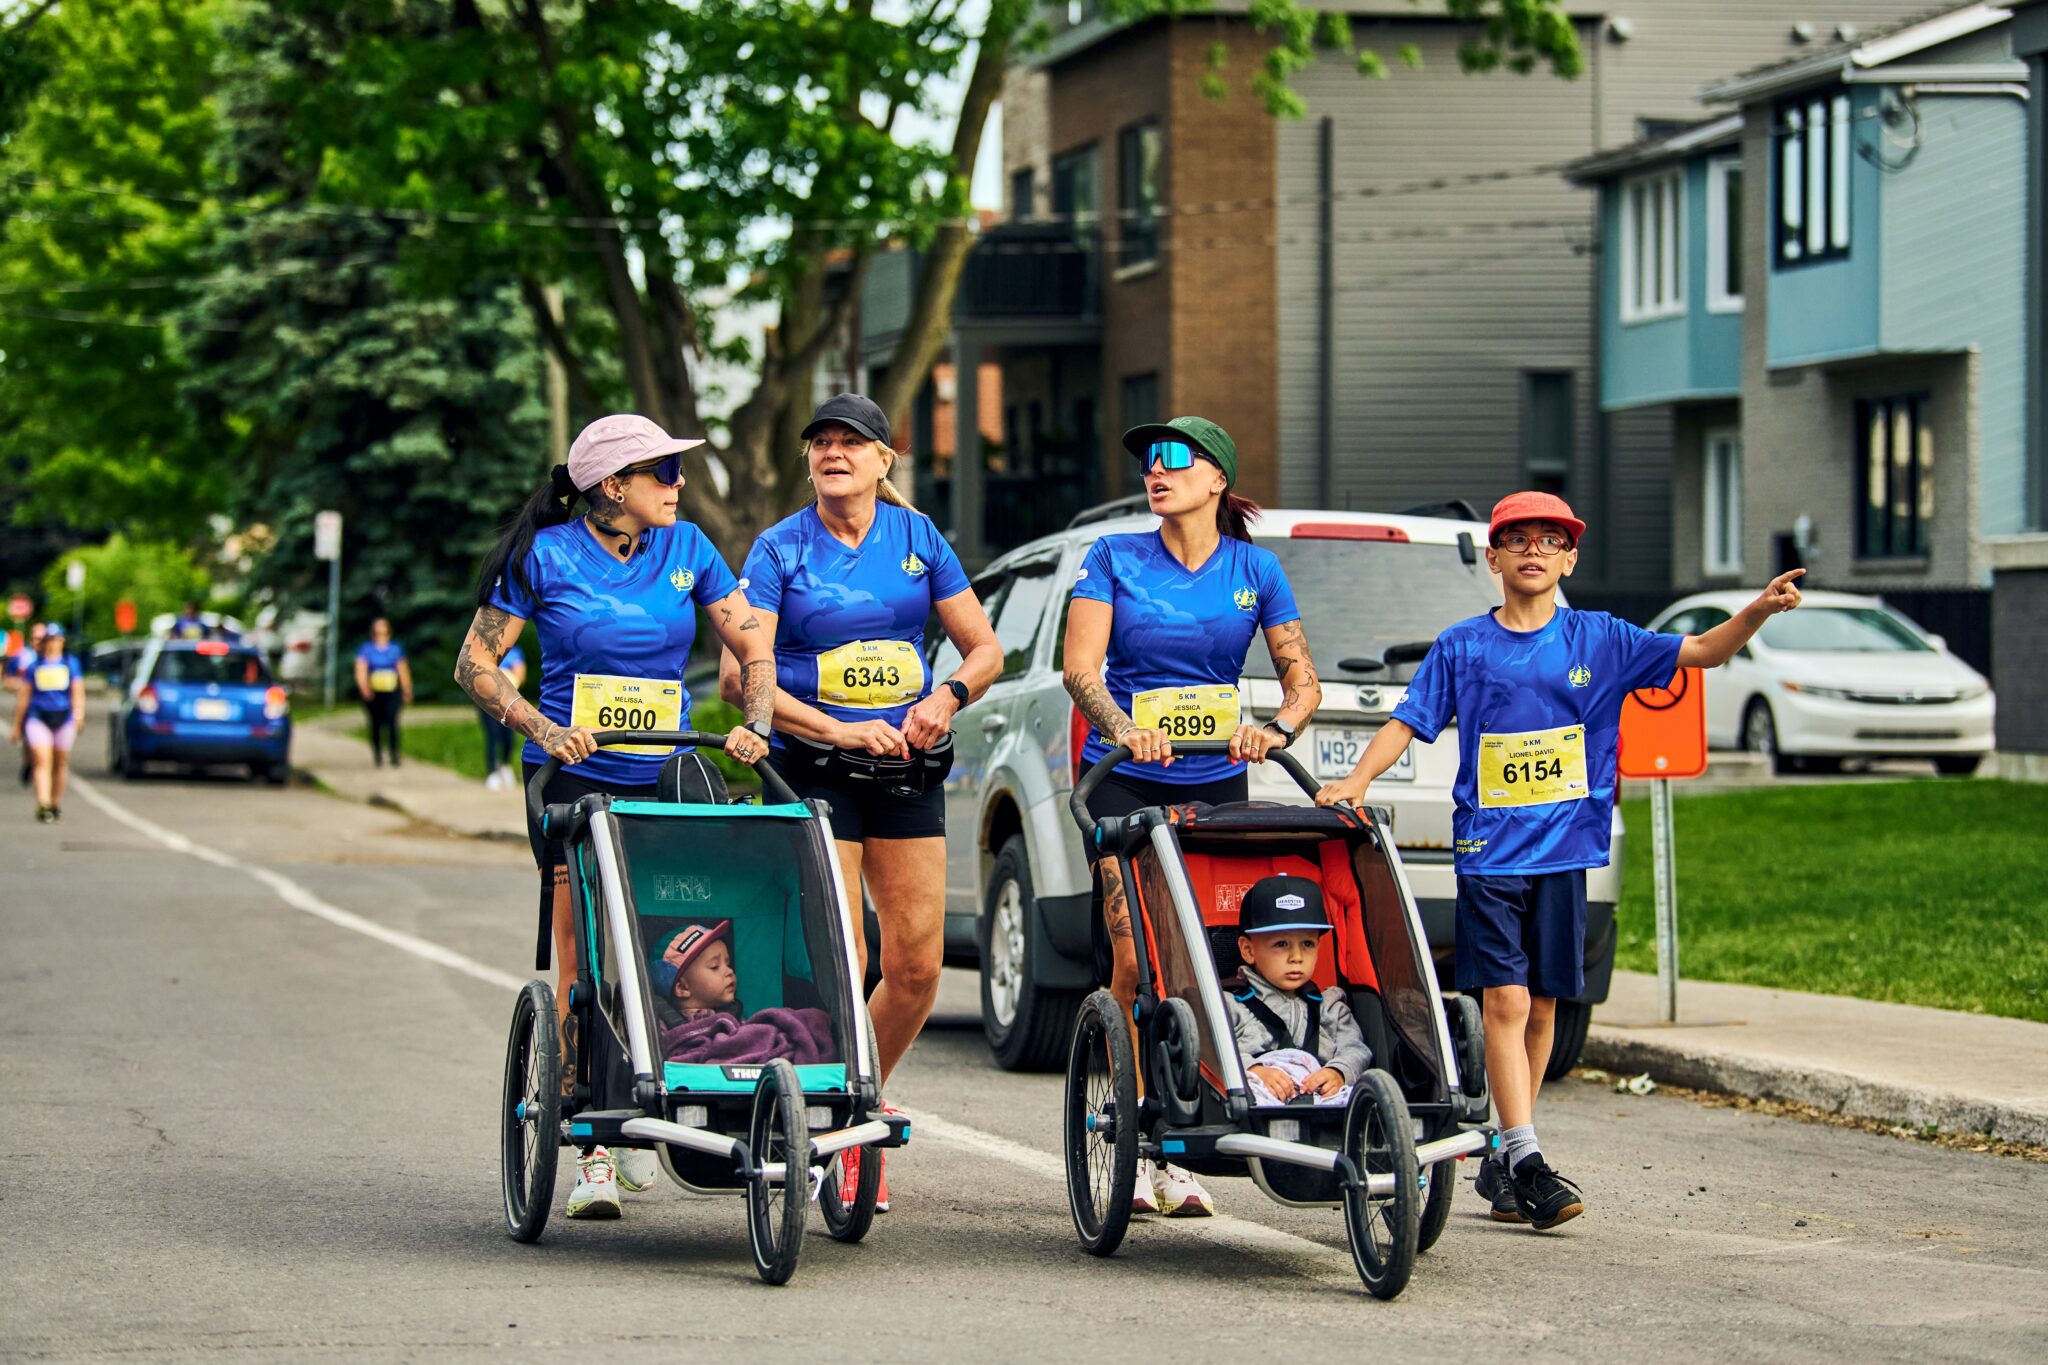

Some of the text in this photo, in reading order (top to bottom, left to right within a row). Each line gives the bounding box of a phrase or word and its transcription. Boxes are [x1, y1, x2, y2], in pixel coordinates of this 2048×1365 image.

[843, 666, 900, 688] 6343
[614, 696, 643, 704] MELISSA
[628, 685, 640, 693] KM
[598, 706, 656, 731] 6900
[1158, 715, 1216, 737] 6899
[1509, 748, 1555, 759] LIONEL DAVID
[1503, 758, 1563, 784] 6154
